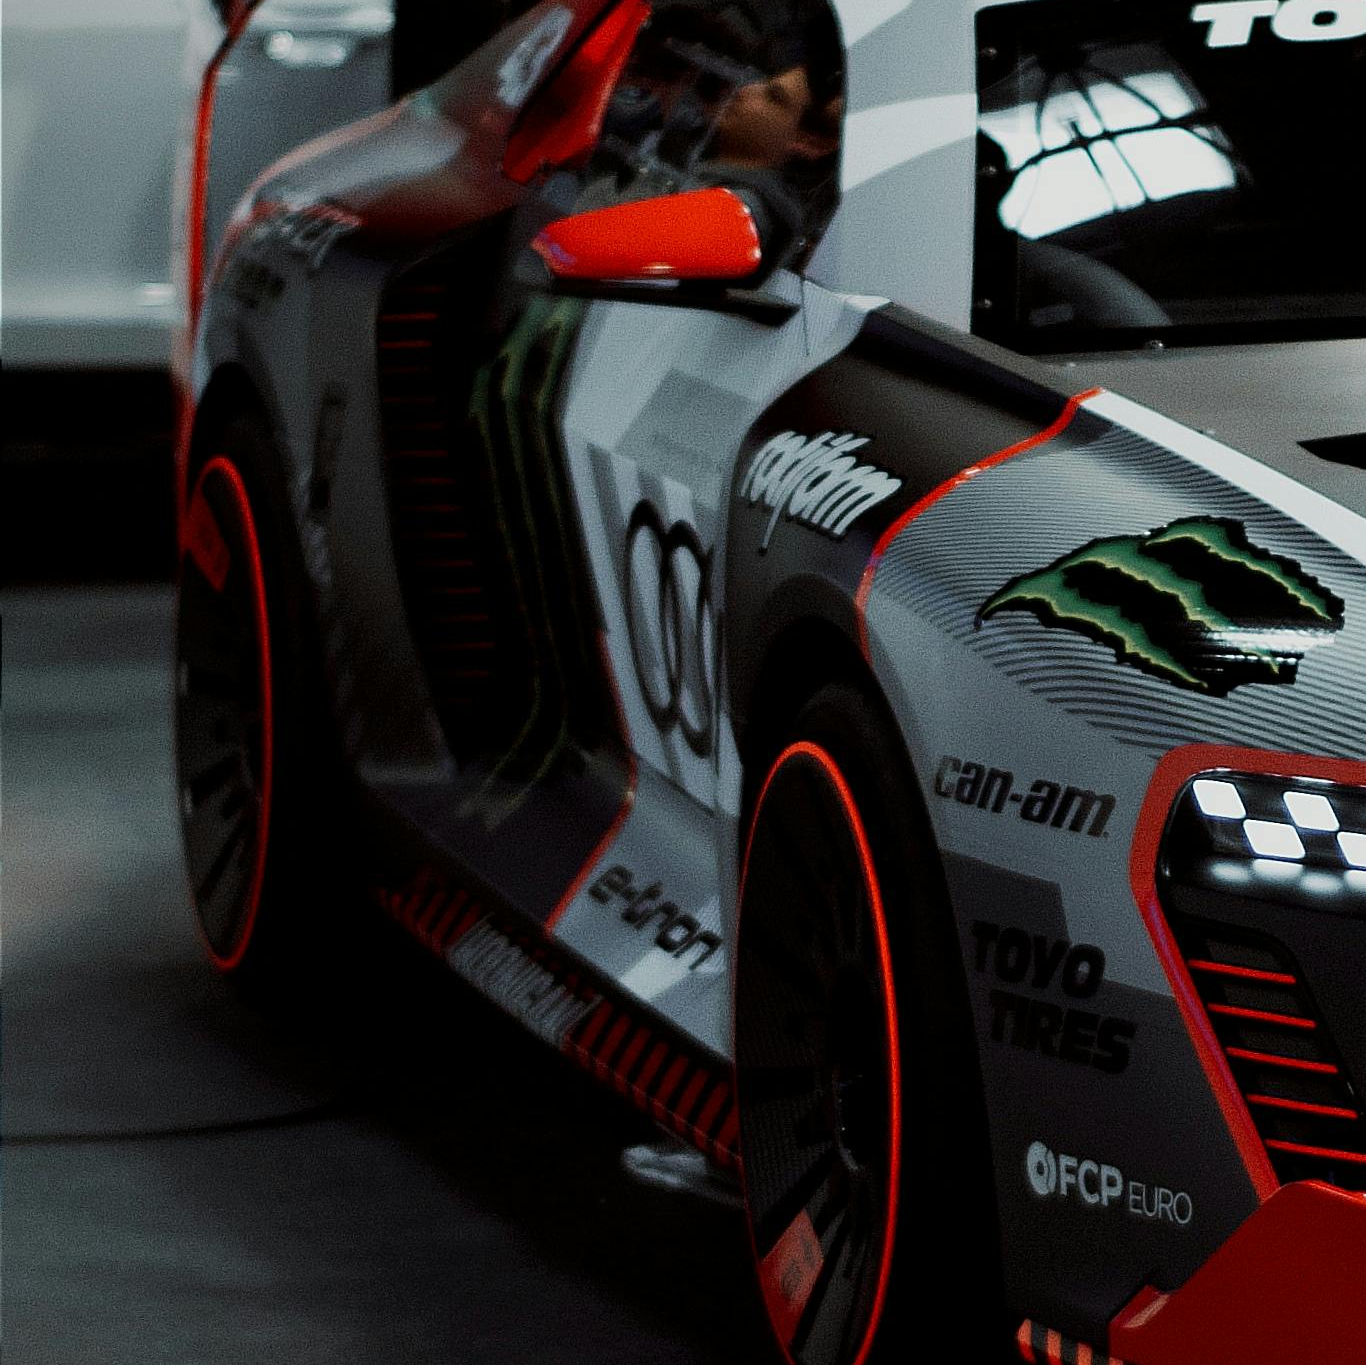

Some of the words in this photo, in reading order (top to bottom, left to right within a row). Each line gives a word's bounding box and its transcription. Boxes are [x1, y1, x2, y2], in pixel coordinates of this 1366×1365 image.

[934, 754, 1116, 837] can-am
[588, 866, 722, 971] e-tron
[972, 920, 1106, 998] TOYO
[989, 990, 1136, 1074] TIRES
[1058, 1152, 1124, 1208] FCP
[1128, 1179, 1193, 1225] EURO
